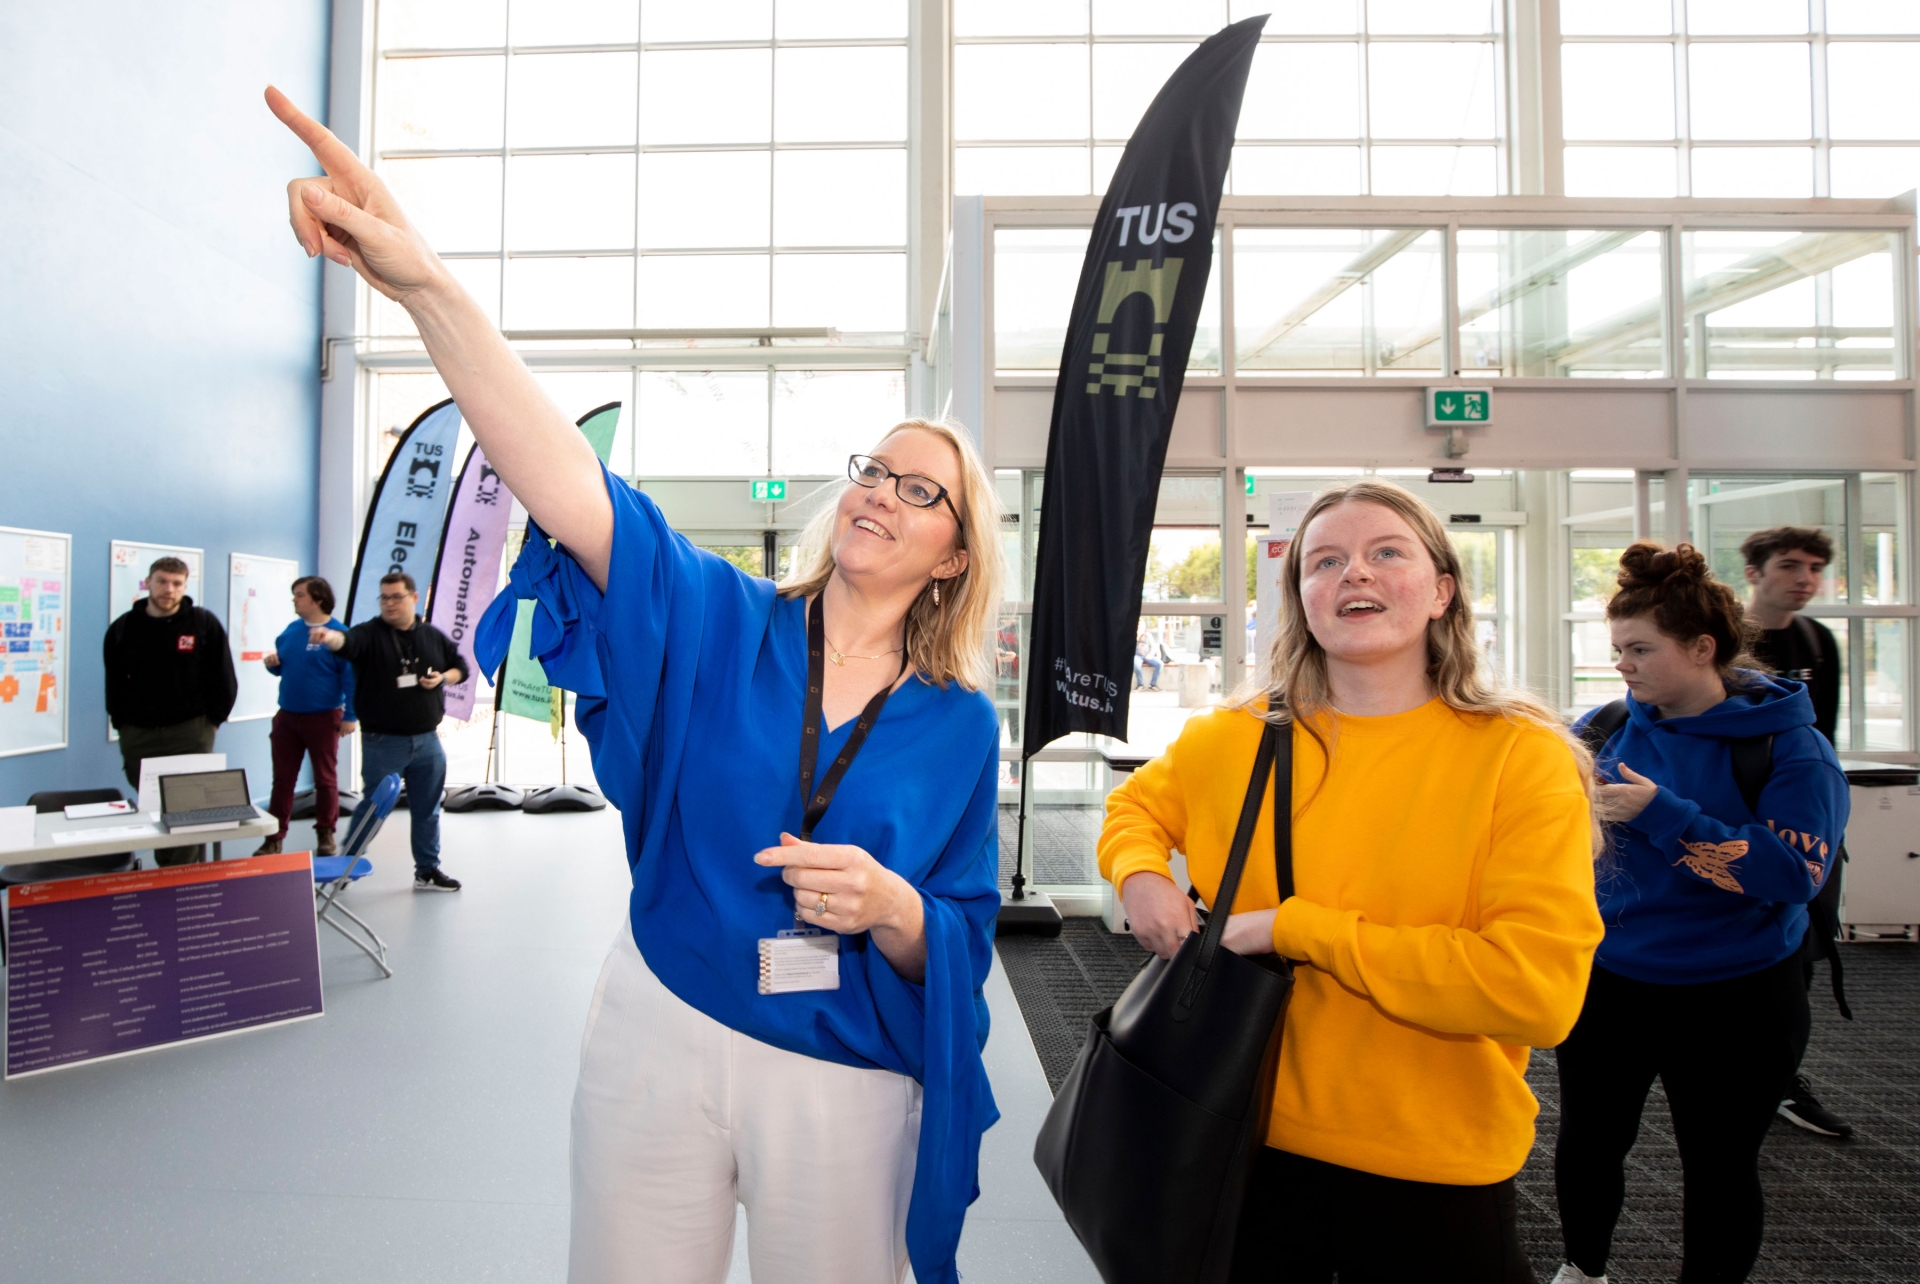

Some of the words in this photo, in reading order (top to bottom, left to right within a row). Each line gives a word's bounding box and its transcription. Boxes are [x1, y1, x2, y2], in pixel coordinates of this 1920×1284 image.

[1115, 202, 1198, 247] TUS
[415, 442, 444, 457] TUS
[452, 527, 481, 648] Automatio
